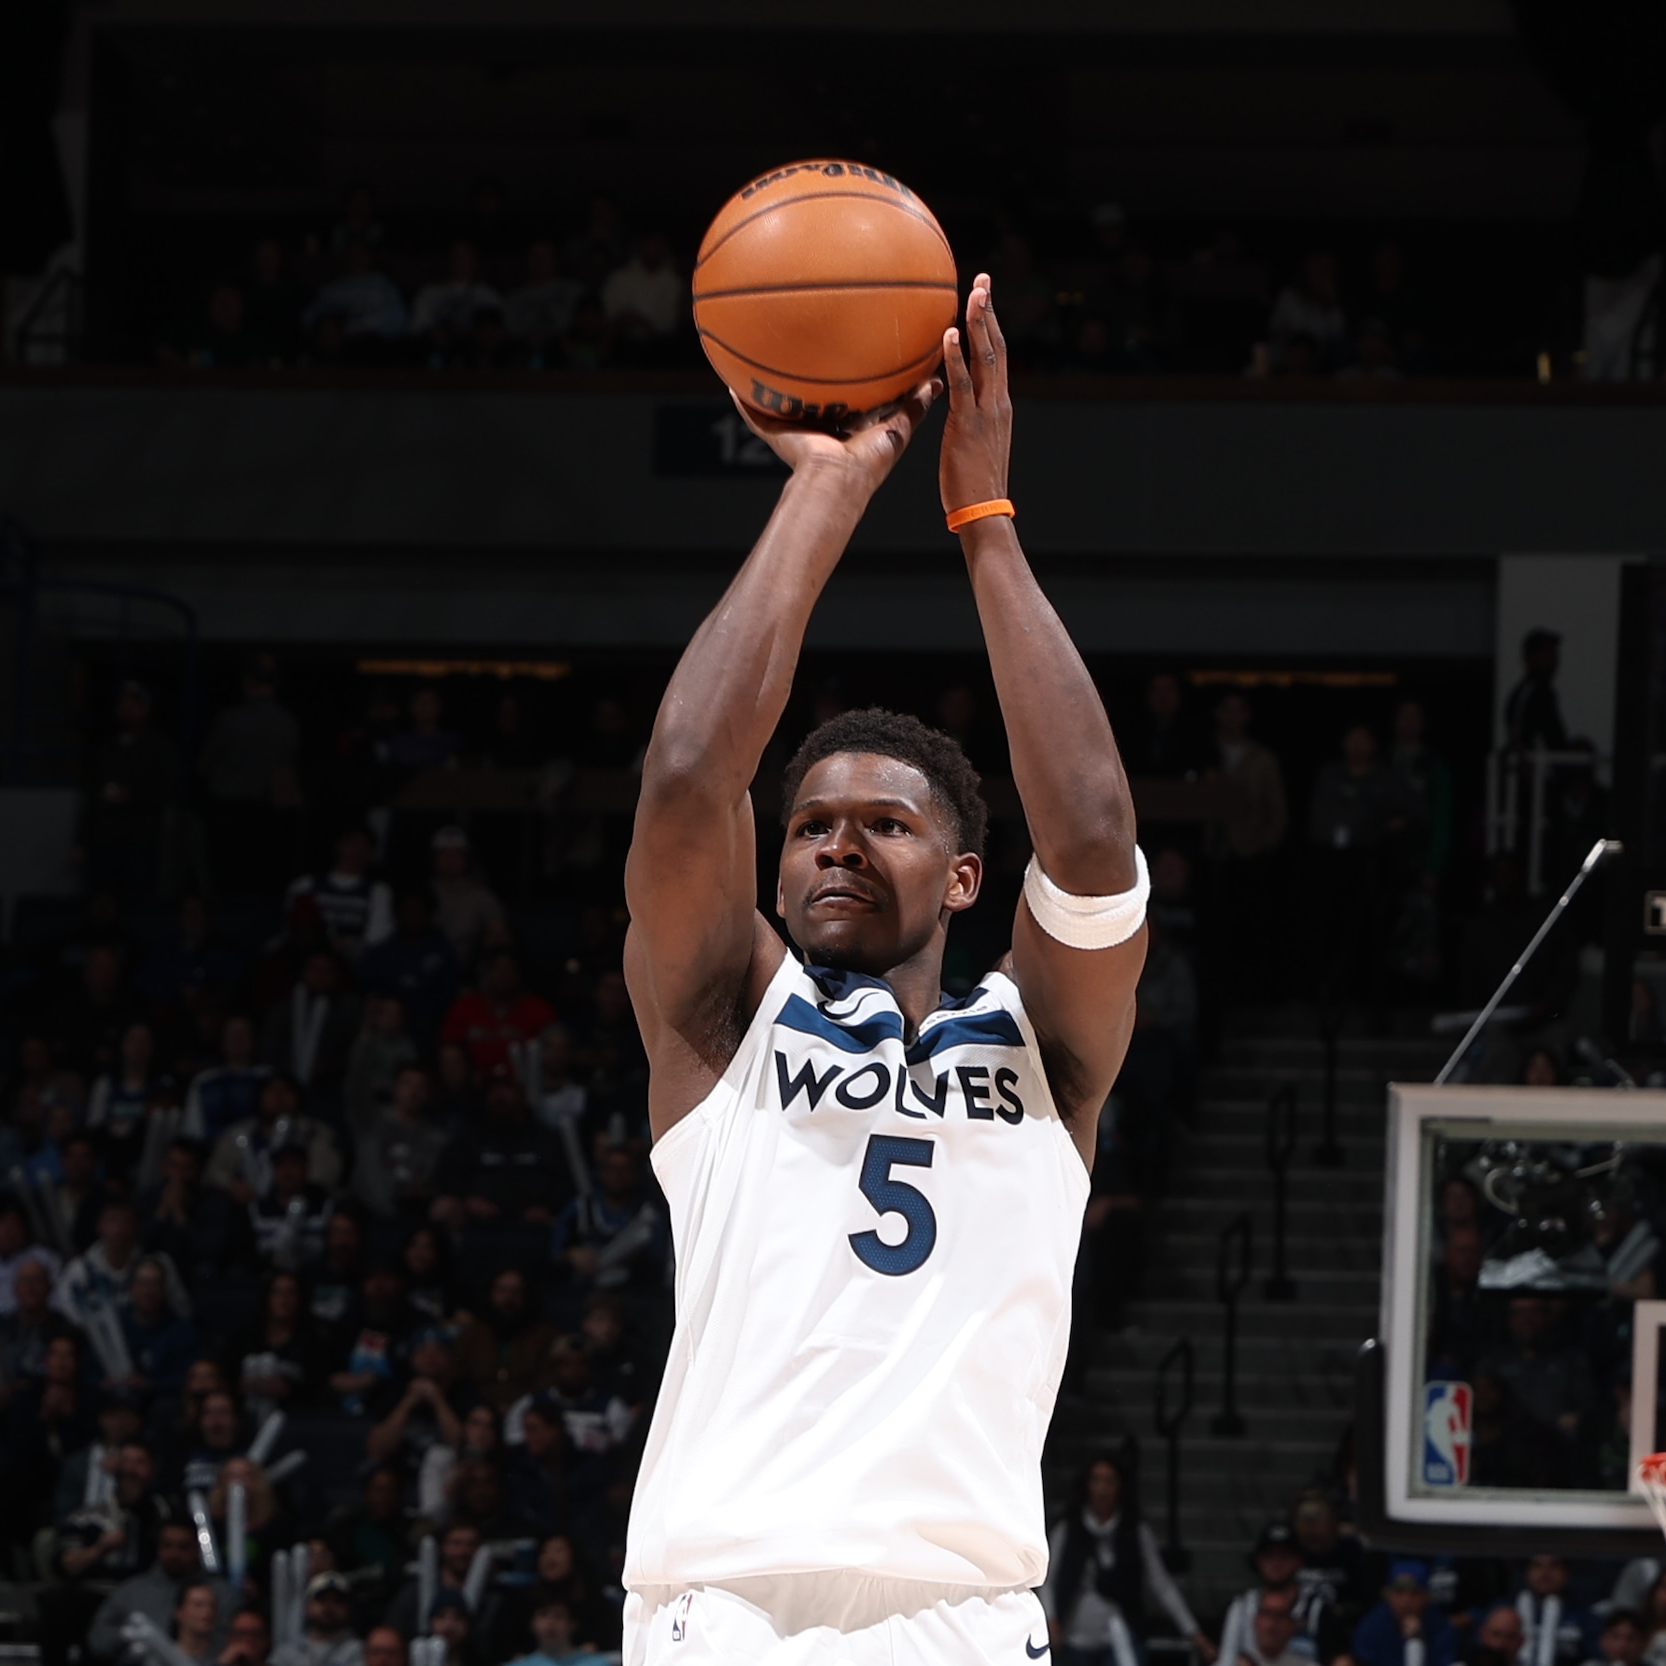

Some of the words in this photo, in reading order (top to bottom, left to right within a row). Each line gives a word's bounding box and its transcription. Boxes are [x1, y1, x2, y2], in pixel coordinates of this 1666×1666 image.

[711, 414, 775, 465] 12
[774, 1048, 1024, 1126] WOLVES
[847, 1133, 938, 1277] 5
